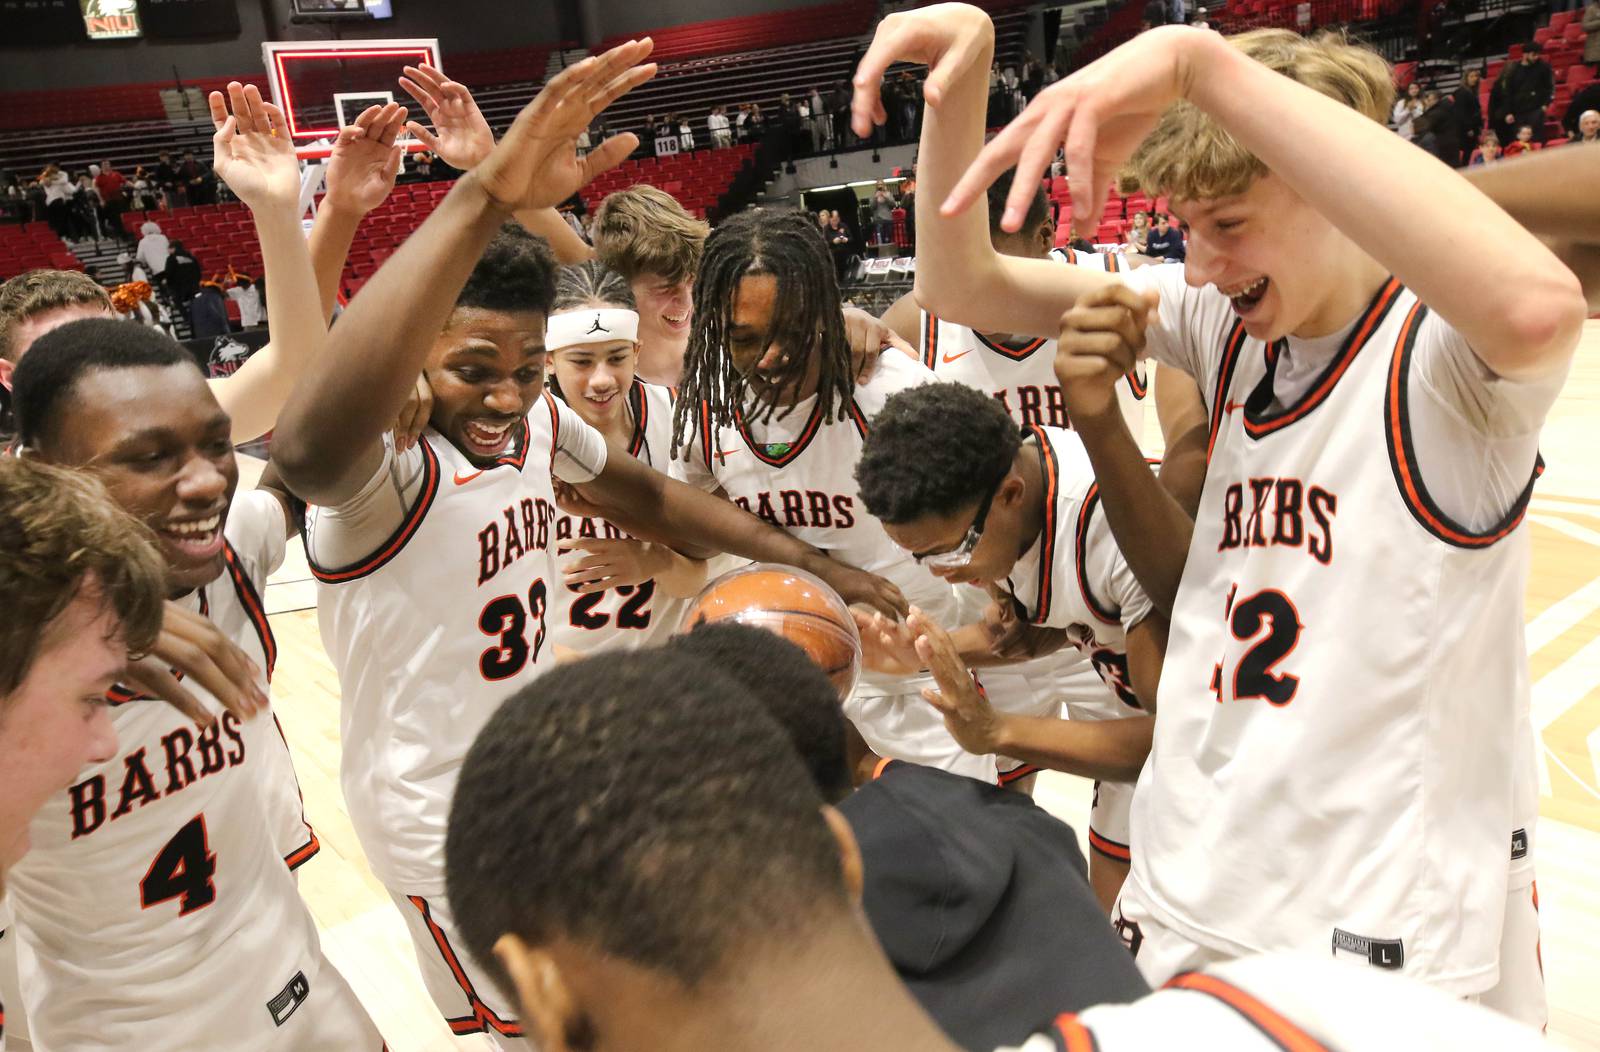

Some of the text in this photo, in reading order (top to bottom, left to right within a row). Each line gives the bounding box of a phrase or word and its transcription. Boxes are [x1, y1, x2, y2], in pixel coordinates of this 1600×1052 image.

[657, 139, 677, 152] 118
[735, 489, 854, 529] ARBS
[67, 708, 246, 841] BARBS
[139, 812, 218, 918] 4
[1382, 948, 1391, 964] L
